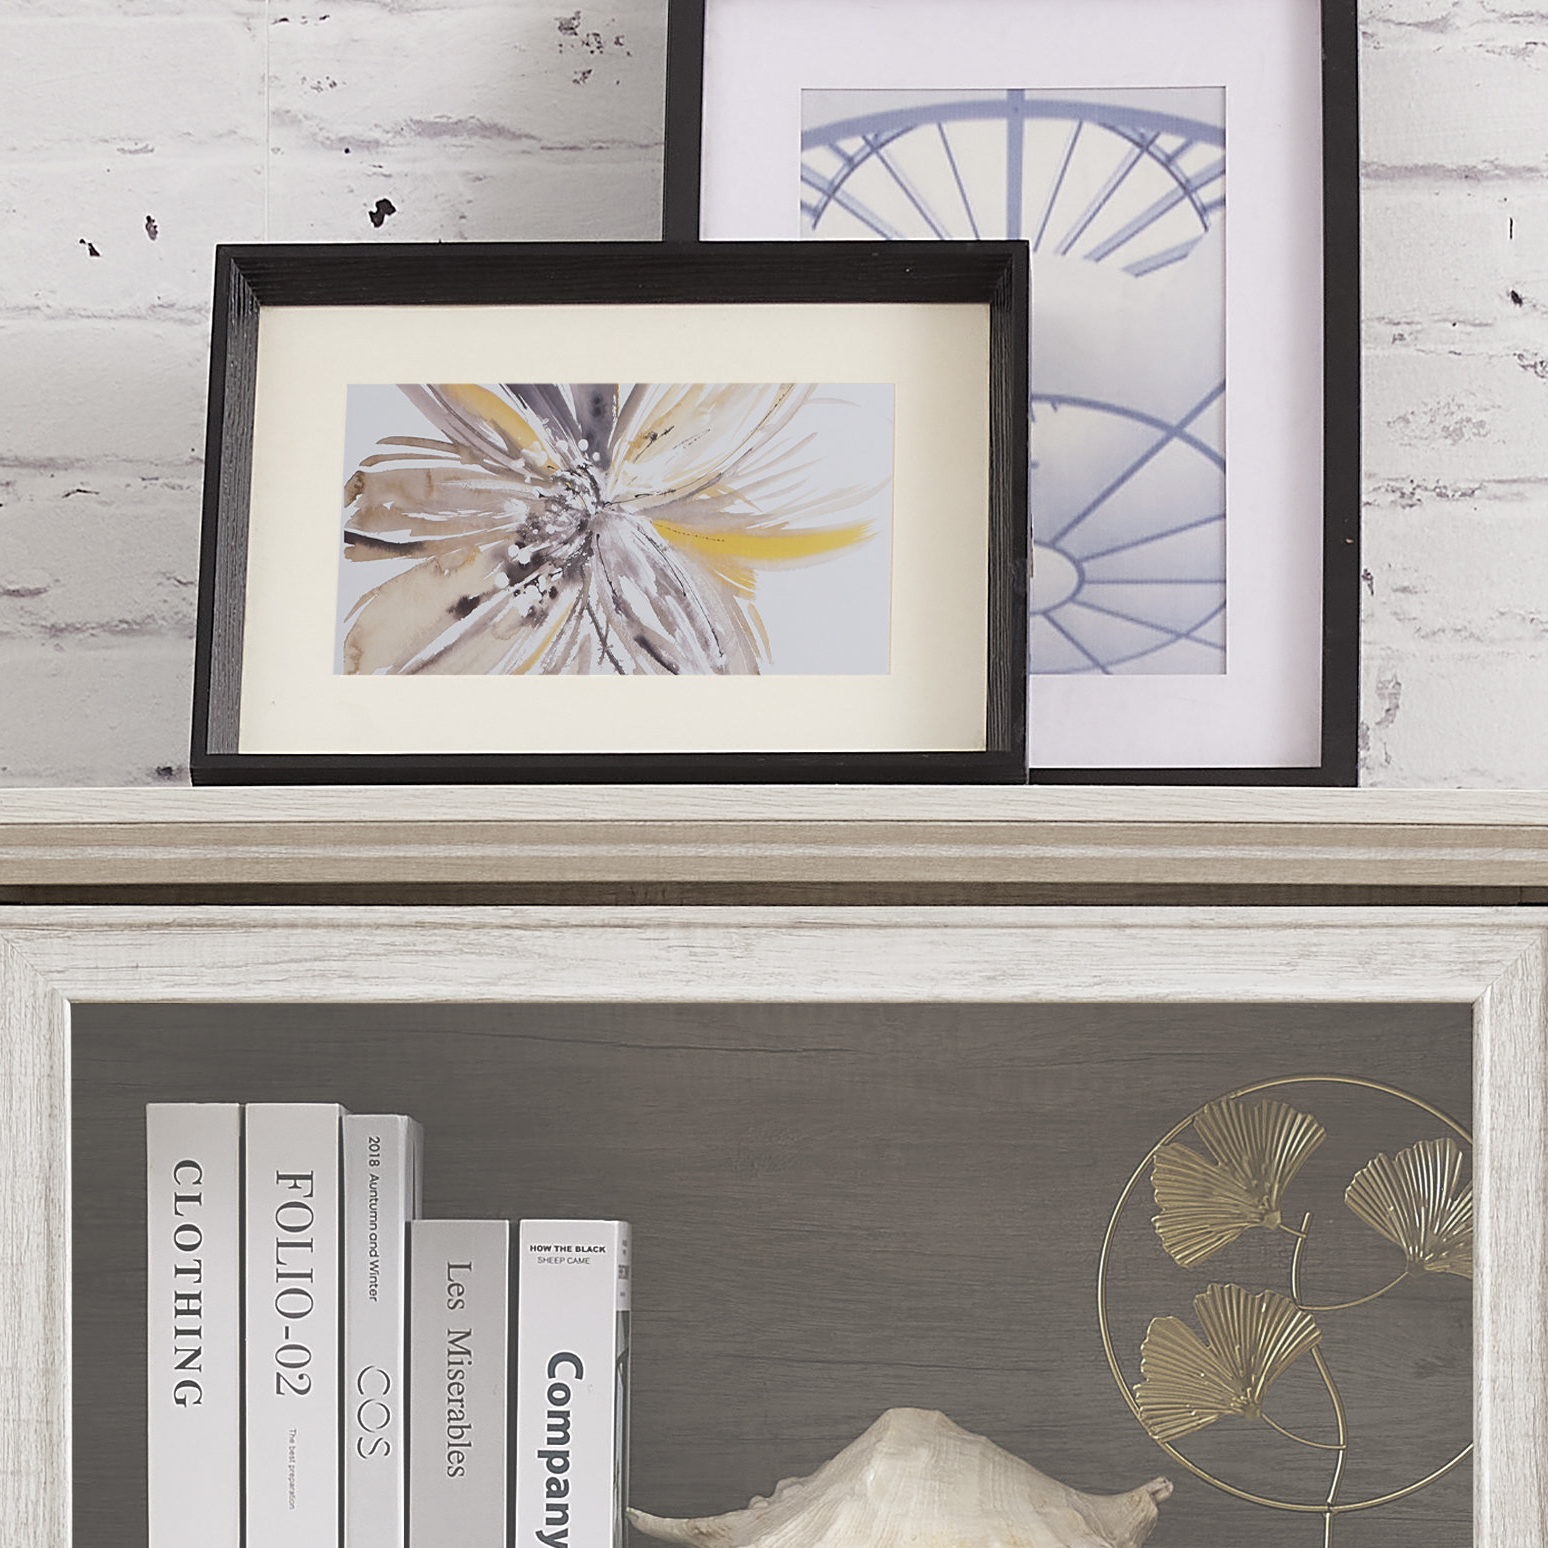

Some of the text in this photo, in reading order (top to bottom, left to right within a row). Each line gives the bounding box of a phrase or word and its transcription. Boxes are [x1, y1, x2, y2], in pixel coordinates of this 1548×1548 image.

[174, 1160, 202, 1407] CLOTHING
[275, 1170, 313, 1395] FOLIO-02
[369, 1137, 380, 1301] 2018 Auntumn and Winter
[537, 1256, 565, 1264] SHEEP
[357, 1366, 390, 1458] COS
[447, 1262, 472, 1477] Les Miserables
